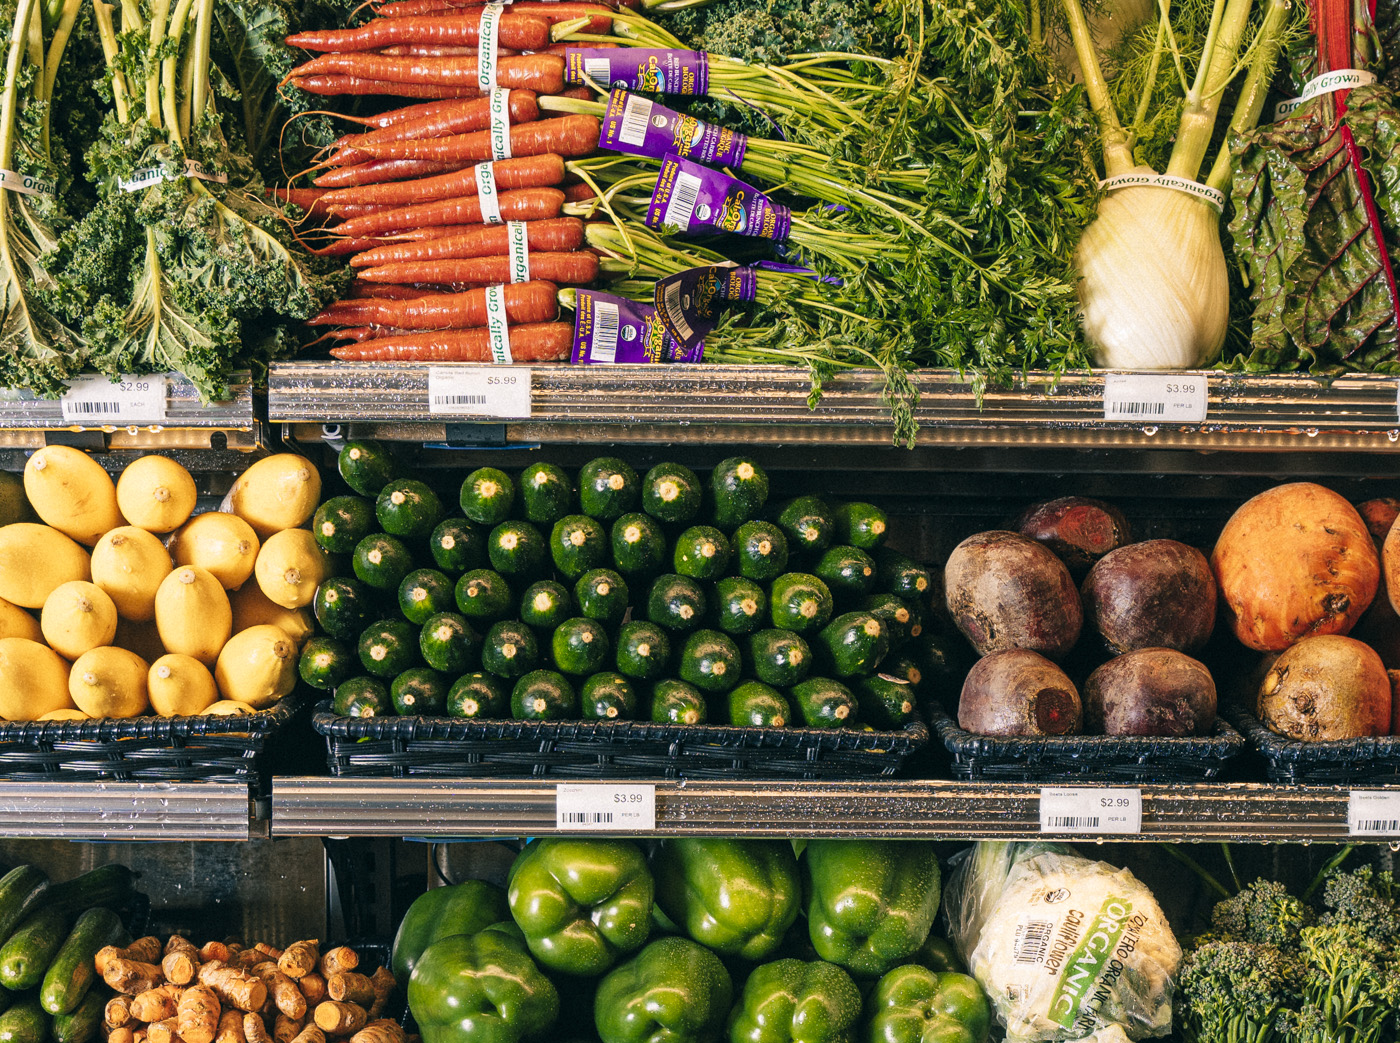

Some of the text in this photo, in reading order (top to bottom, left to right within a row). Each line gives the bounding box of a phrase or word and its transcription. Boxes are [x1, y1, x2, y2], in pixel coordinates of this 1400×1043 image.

[1321, 74, 1359, 88] Grown
[487, 377, 516, 385] $5.99
[120, 383, 149, 391] $2.99
[1166, 384, 1195, 393] $3.99
[614, 794, 642, 803] $3.99
[1100, 798, 1130, 807] $2.99
[1037, 923, 1053, 963] ORGANIC
[1044, 909, 1084, 975] cauliflower
[1054, 902, 1125, 1015] ORGANIC
